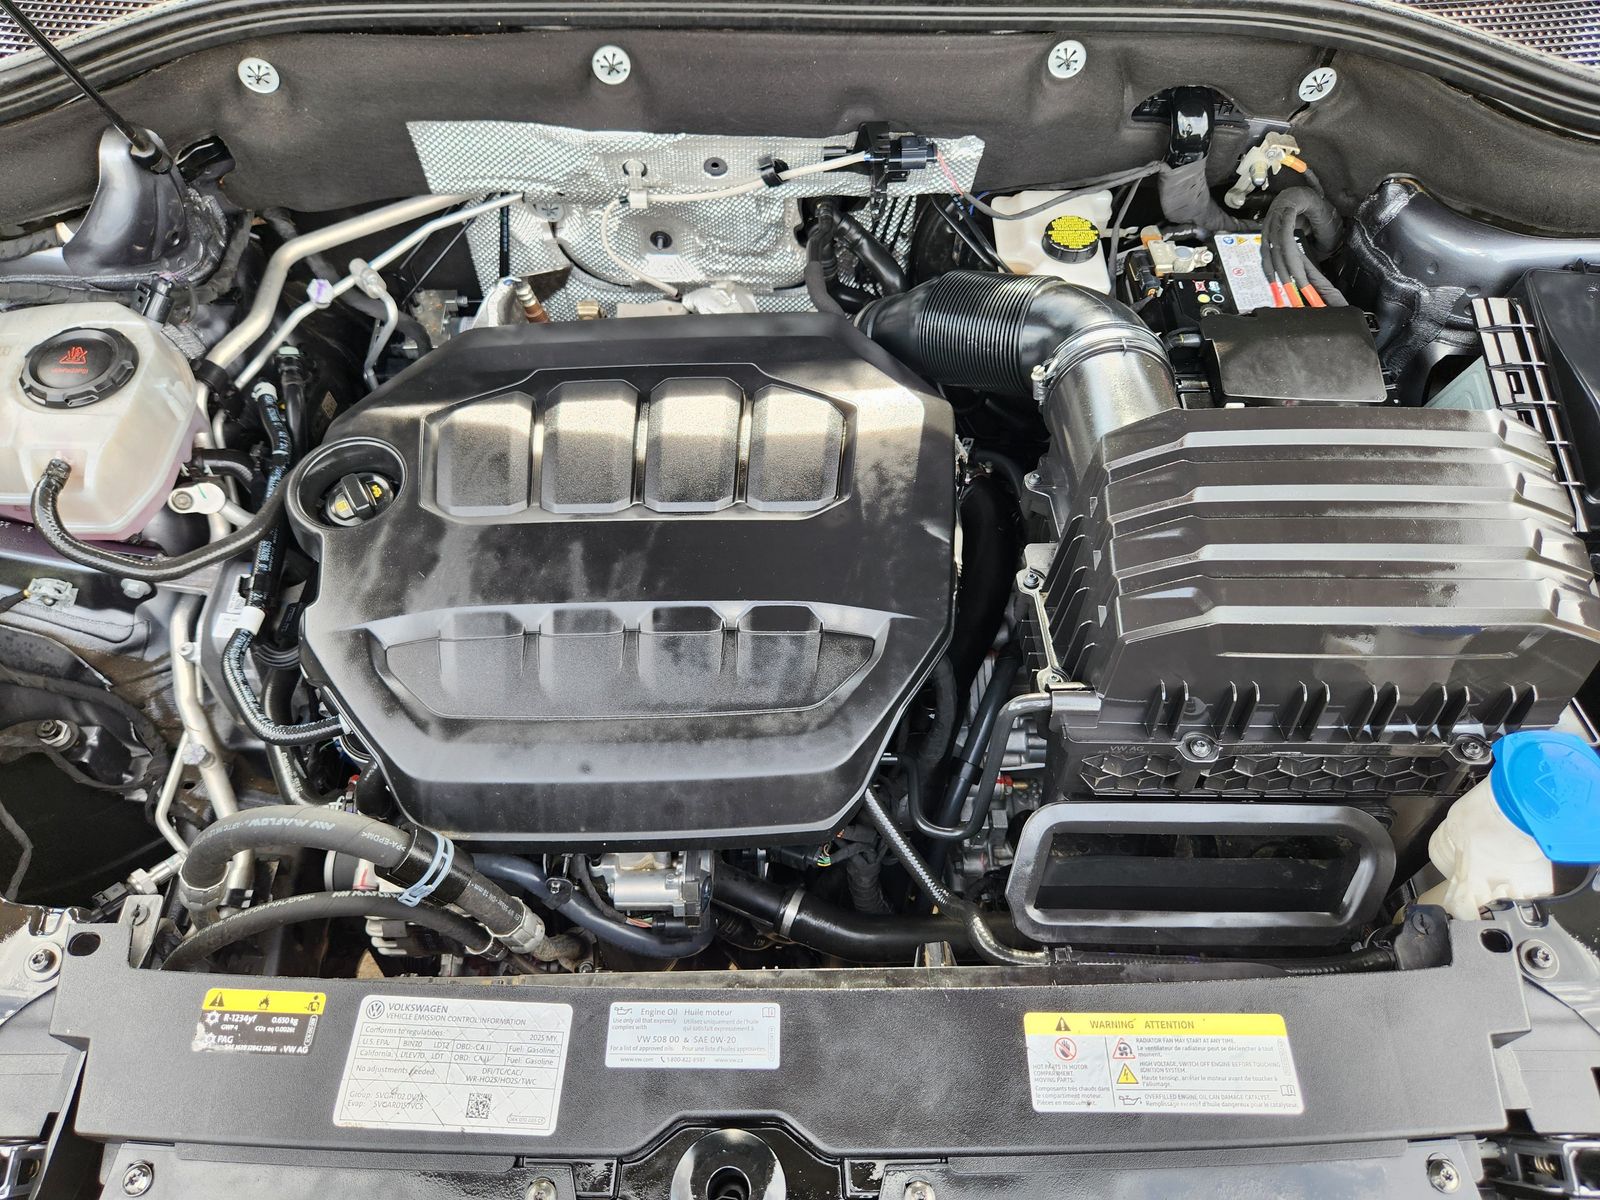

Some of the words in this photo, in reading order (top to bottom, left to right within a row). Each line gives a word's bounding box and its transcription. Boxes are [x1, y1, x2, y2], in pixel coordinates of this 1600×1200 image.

[388, 1003, 448, 1013] VOLKSWAGEN
[641, 1008, 665, 1017] Engine
[223, 1014, 257, 1024] R-1234yf
[290, 1017, 299, 1026] kg
[480, 1017, 526, 1026] INFORMATION
[1090, 1020, 1134, 1029] WARNING
[1144, 1020, 1194, 1029] ATTENTION
[218, 1035, 234, 1044] PAG
[366, 1065, 408, 1074] adjustments
